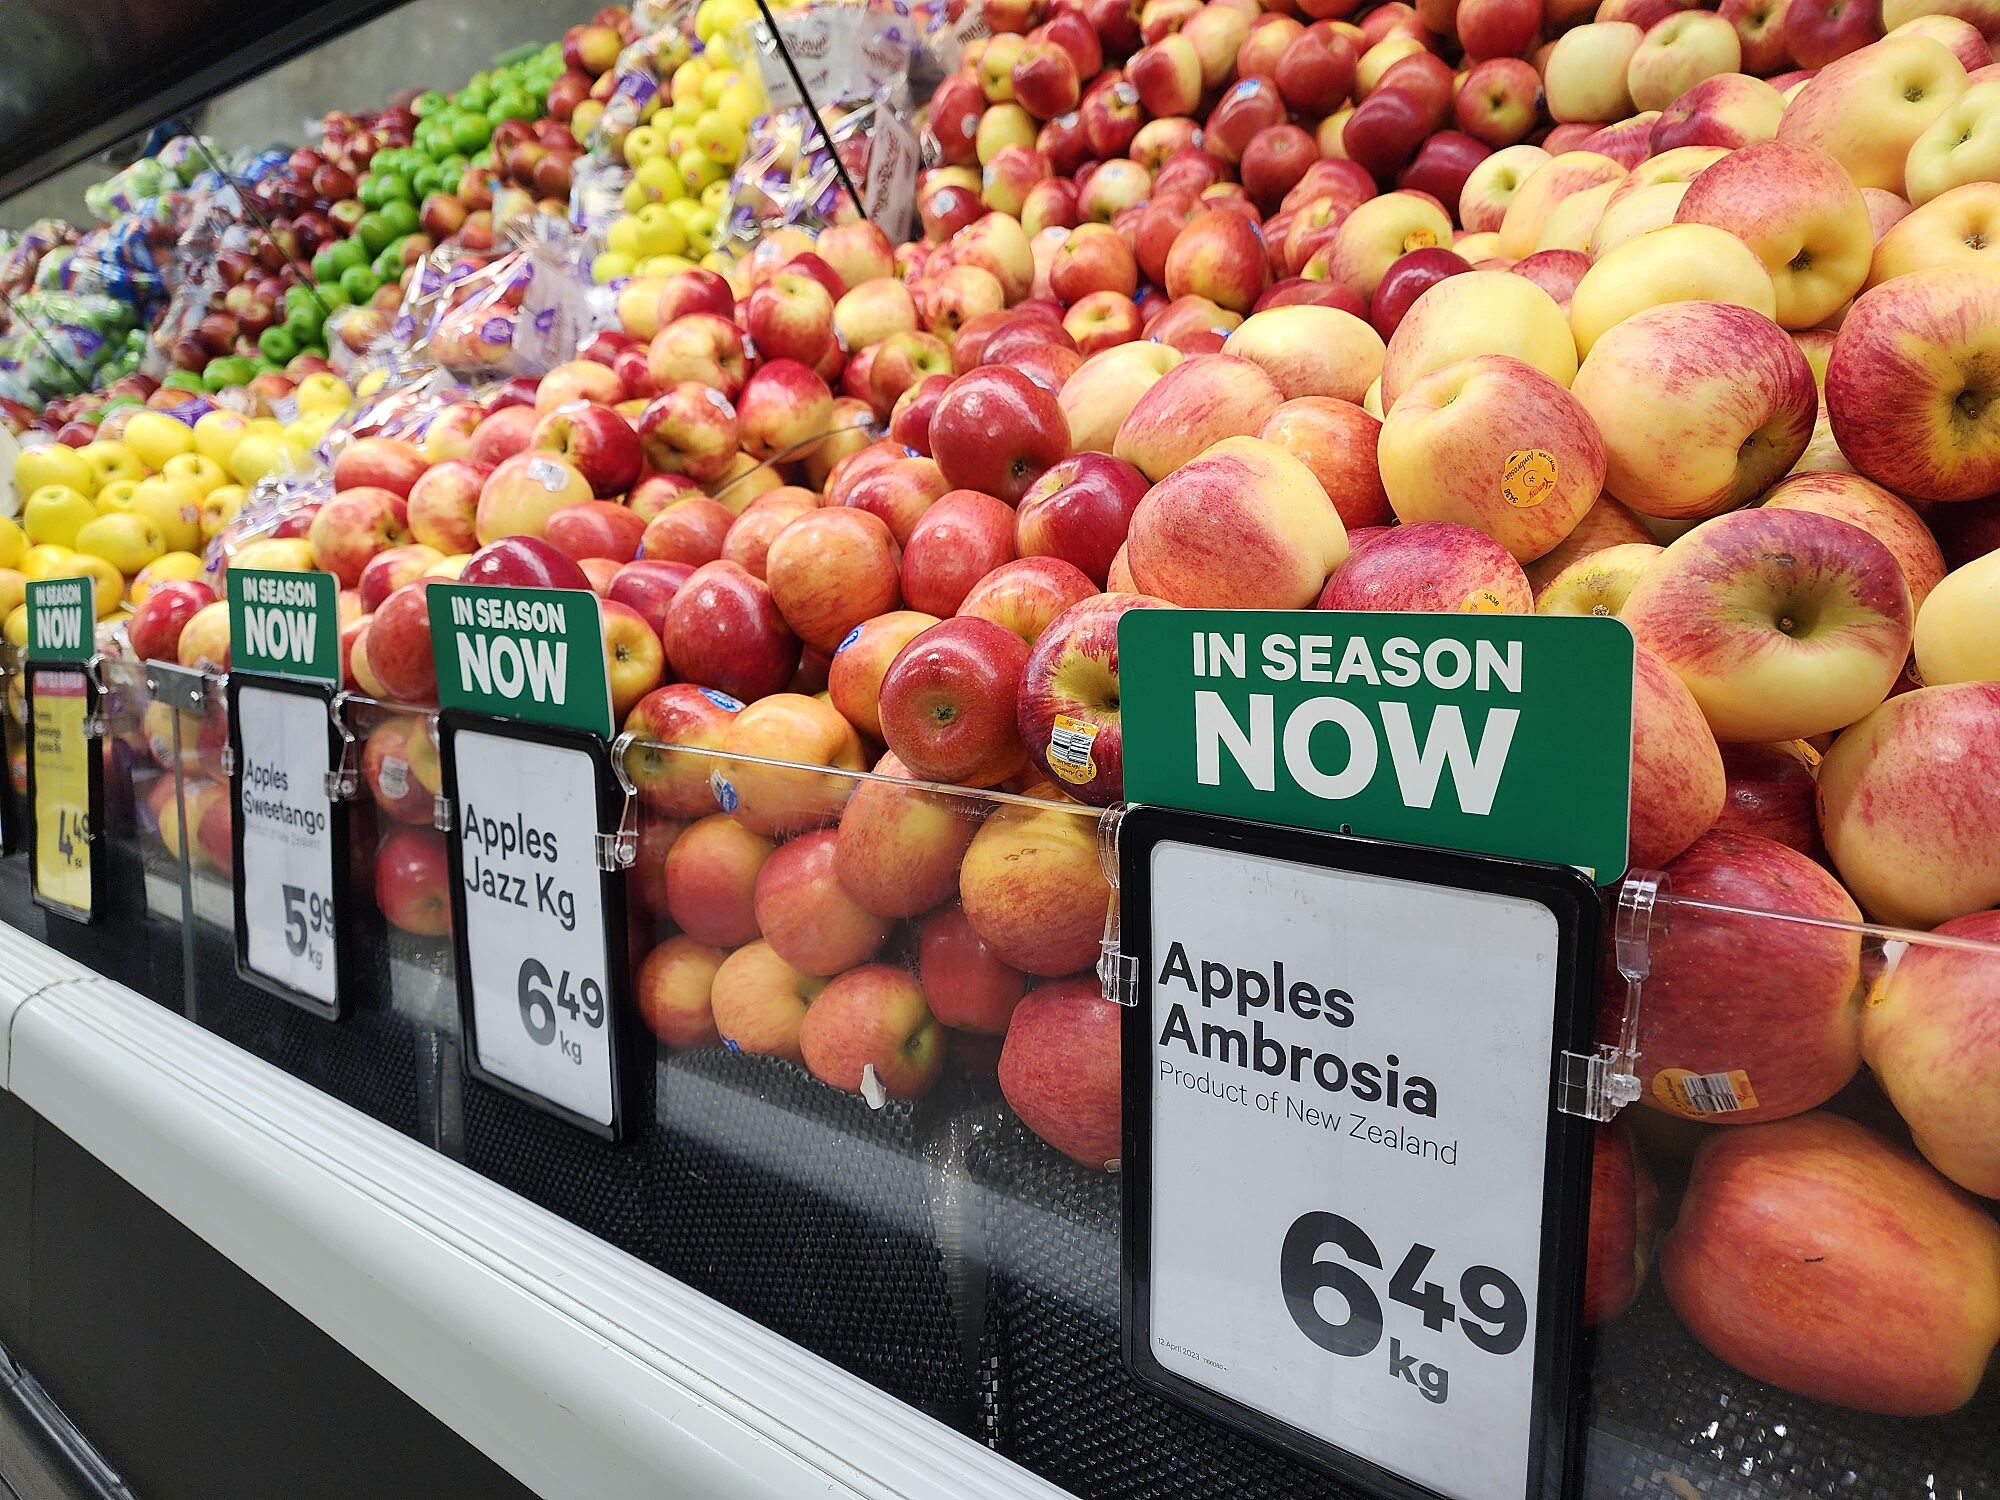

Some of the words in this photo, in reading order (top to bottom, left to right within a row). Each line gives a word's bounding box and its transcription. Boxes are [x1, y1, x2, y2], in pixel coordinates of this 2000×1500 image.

[36, 586, 46, 607] IN
[46, 583, 82, 606] SEASON
[243, 576, 259, 603] IN
[258, 577, 317, 608] SEASON
[451, 596, 475, 626] IN
[475, 598, 567, 635] SEASON
[36, 606, 82, 650] NOW
[244, 605, 318, 665] NOW
[456, 632, 568, 705] NOW
[1192, 631, 1246, 679] IN
[1261, 633, 1524, 693] SEASON
[244, 758, 288, 792] Apples
[1195, 690, 1521, 817] NOW
[243, 790, 325, 835] Sweetango
[464, 803, 558, 863] Apples
[465, 856, 528, 908] Jazz
[535, 872, 576, 932] Kg
[308, 941, 323, 971] kg
[1158, 940, 1356, 1029] Apples
[559, 1030, 583, 1066] kg
[1158, 1002, 1438, 1119] Ambrosia
[1159, 1059, 1249, 1107] Product
[1255, 1089, 1279, 1114] of
[1286, 1101, 1342, 1133] New
[1349, 1113, 1458, 1167] Zealand
[1157, 1337, 1165, 1347] 12
[1165, 1341, 1182, 1354] April
[1182, 1347, 1200, 1361] 2023
[1388, 1337, 1449, 1405] kg
